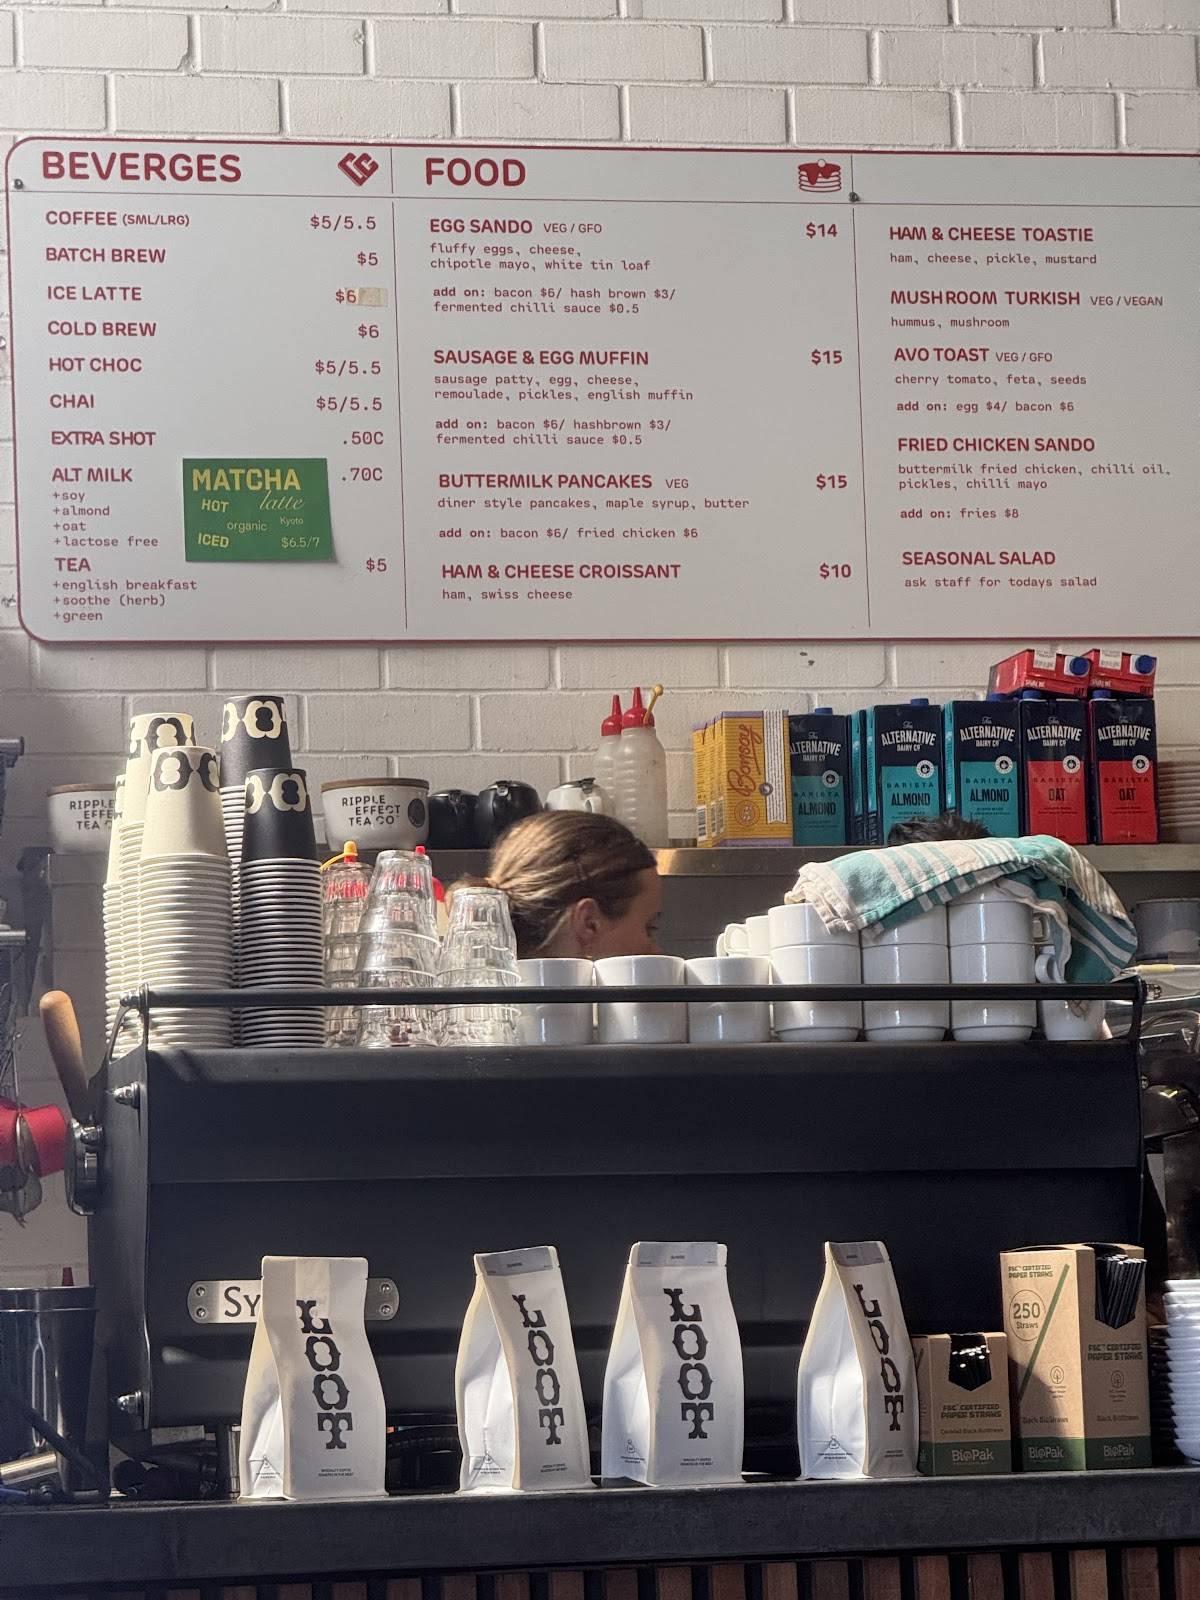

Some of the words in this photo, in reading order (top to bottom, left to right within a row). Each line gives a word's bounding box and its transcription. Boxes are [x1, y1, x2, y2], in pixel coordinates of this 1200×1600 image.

[43, 151, 241, 182] BEVERGES
[426, 158, 525, 186] FOOD
[46, 211, 117, 226] COFFEE
[123, 214, 189, 227] (SML/LRG)
[311, 214, 376, 231] $5/5.5
[430, 219, 465, 233] EGG
[470, 219, 532, 233] SANDO
[806, 222, 837, 238] $14
[890, 227, 926, 240] HAM
[932, 227, 944, 240] &
[948, 227, 1015, 241] CHEESE
[1022, 228, 1093, 241] TOASTIE
[46, 248, 105, 262] BATCH
[112, 249, 165, 263] BREW
[430, 243, 475, 256] fluffy
[484, 246, 520, 256] eggs,
[530, 244, 580, 257] cheese,
[358, 251, 378, 266] $5
[431, 258, 491, 270] chipotle
[499, 261, 535, 272] mayo,
[545, 259, 582, 269] white
[591, 259, 612, 270] tin
[621, 260, 650, 270] loaf
[48, 286, 76, 300] ICE
[83, 287, 141, 301] LATTE
[336, 289, 356, 304] $6
[433, 287, 456, 296] add
[495, 287, 532, 297] bacon
[541, 287, 562, 299] $6/
[571, 288, 600, 298] hash
[609, 289, 645, 298] brown
[654, 289, 675, 300] $3/
[891, 291, 997, 304] MUSHROOM
[1005, 291, 1080, 305] TURKISH
[434, 301, 502, 312] fermented
[511, 302, 555, 312] chilli
[610, 303, 639, 313] $0.5
[48, 321, 96, 336] COLD
[103, 322, 156, 336] BREW
[891, 317, 941, 328] hummus,
[951, 317, 1009, 327] mushroom
[358, 324, 379, 338] $6
[434, 350, 517, 364] SAUSAGE
[523, 351, 534, 364] &
[540, 351, 574, 364] EGG
[580, 351, 648, 365] MUFFIN
[812, 349, 842, 365] $15
[894, 348, 929, 361] AVO
[933, 348, 989, 361] TOAST
[49, 358, 85, 371] HOT
[90, 358, 141, 372] CHOC
[315, 360, 380, 376] $5/5.5
[895, 374, 939, 386] cherry
[947, 375, 997, 386] tomato,
[1007, 374, 1041, 386] feta,
[1051, 375, 1086, 384] seeds
[50, 394, 94, 408] CHAI
[435, 389, 509, 401] remoulade,
[519, 388, 578, 401] pickles,
[588, 389, 640, 402] english
[648, 389, 693, 400] muffin
[317, 396, 382, 413] $5/5.5
[52, 431, 104, 445] EXTRA
[110, 431, 156, 445] SHOT
[344, 431, 383, 445] .50C
[898, 438, 948, 451] FRIED
[953, 438, 1029, 451] CHICKEN
[1035, 438, 1094, 452] SANDO
[52, 468, 83, 482] ALT
[88, 468, 132, 482] MILK
[342, 468, 382, 481] .70C
[899, 464, 972, 474] buttermilk
[981, 464, 1017, 474] fried
[1025, 464, 1082, 476] chicken,
[1091, 464, 1134, 474] chilli
[192, 468, 301, 491] MATCHA
[439, 474, 552, 488] BUTTERMILK
[558, 475, 652, 488] PANCAKES
[817, 474, 847, 490] $15
[201, 498, 229, 512] HOT
[259, 490, 304, 510] latte
[901, 508, 922, 518] add
[960, 508, 996, 518] fries
[1005, 508, 1019, 518] $8
[227, 520, 268, 533] organic
[280, 516, 304, 526] Kyoto
[128, 536, 158, 546] free
[197, 532, 229, 548] ICED
[281, 537, 320, 549] $6.5/7
[55, 558, 91, 572] TEA
[366, 557, 387, 572] $5
[903, 552, 995, 565] SEASONAL
[1000, 552, 1055, 565] SALAD
[442, 565, 482, 578] HAM
[488, 565, 499, 579] &
[505, 565, 574, 578] CHEESE
[579, 564, 681, 578] CROISSANT
[820, 563, 851, 579] $10
[126, 579, 197, 590] breakfast
[905, 577, 926, 587] ask
[935, 577, 970, 587] staff
[980, 577, 1000, 587] for
[1008, 577, 1052, 588] todays
[1061, 577, 1097, 586] salad
[120, 594, 165, 606] (herb)
[443, 589, 471, 601] ham,
[481, 588, 519, 599] swiss
[528, 589, 572, 599] cheese
[880, 730, 936, 746] ALTERNATIVE
[960, 725, 1015, 742] ALTERNATIVE
[1026, 725, 1082, 741] ALTERNATIVE
[1097, 725, 1152, 740] ALTERNATIVE
[342, 794, 386, 806] RIPPLE
[891, 792, 931, 806] ALMOND
[970, 788, 1009, 802] ALMOND
[1048, 788, 1065, 800] OAT
[1120, 788, 1136, 800] OAT
[70, 799, 116, 810] RIPPLE
[356, 804, 400, 815] EFFECT
[798, 802, 836, 816] ALMOND
[76, 821, 100, 830] TEA
[349, 817, 371, 826] TEA
[1013, 1302, 1040, 1319] 250
[663, 1288, 714, 1439] LOOT
[853, 1284, 904, 1431] LOOT
[296, 1300, 353, 1450] LOOT
[512, 1294, 566, 1445] LOOT
[952, 1448, 994, 1462] BioPak
[1028, 1445, 1064, 1459] BioPak
[1103, 1444, 1135, 1457] BioPak
